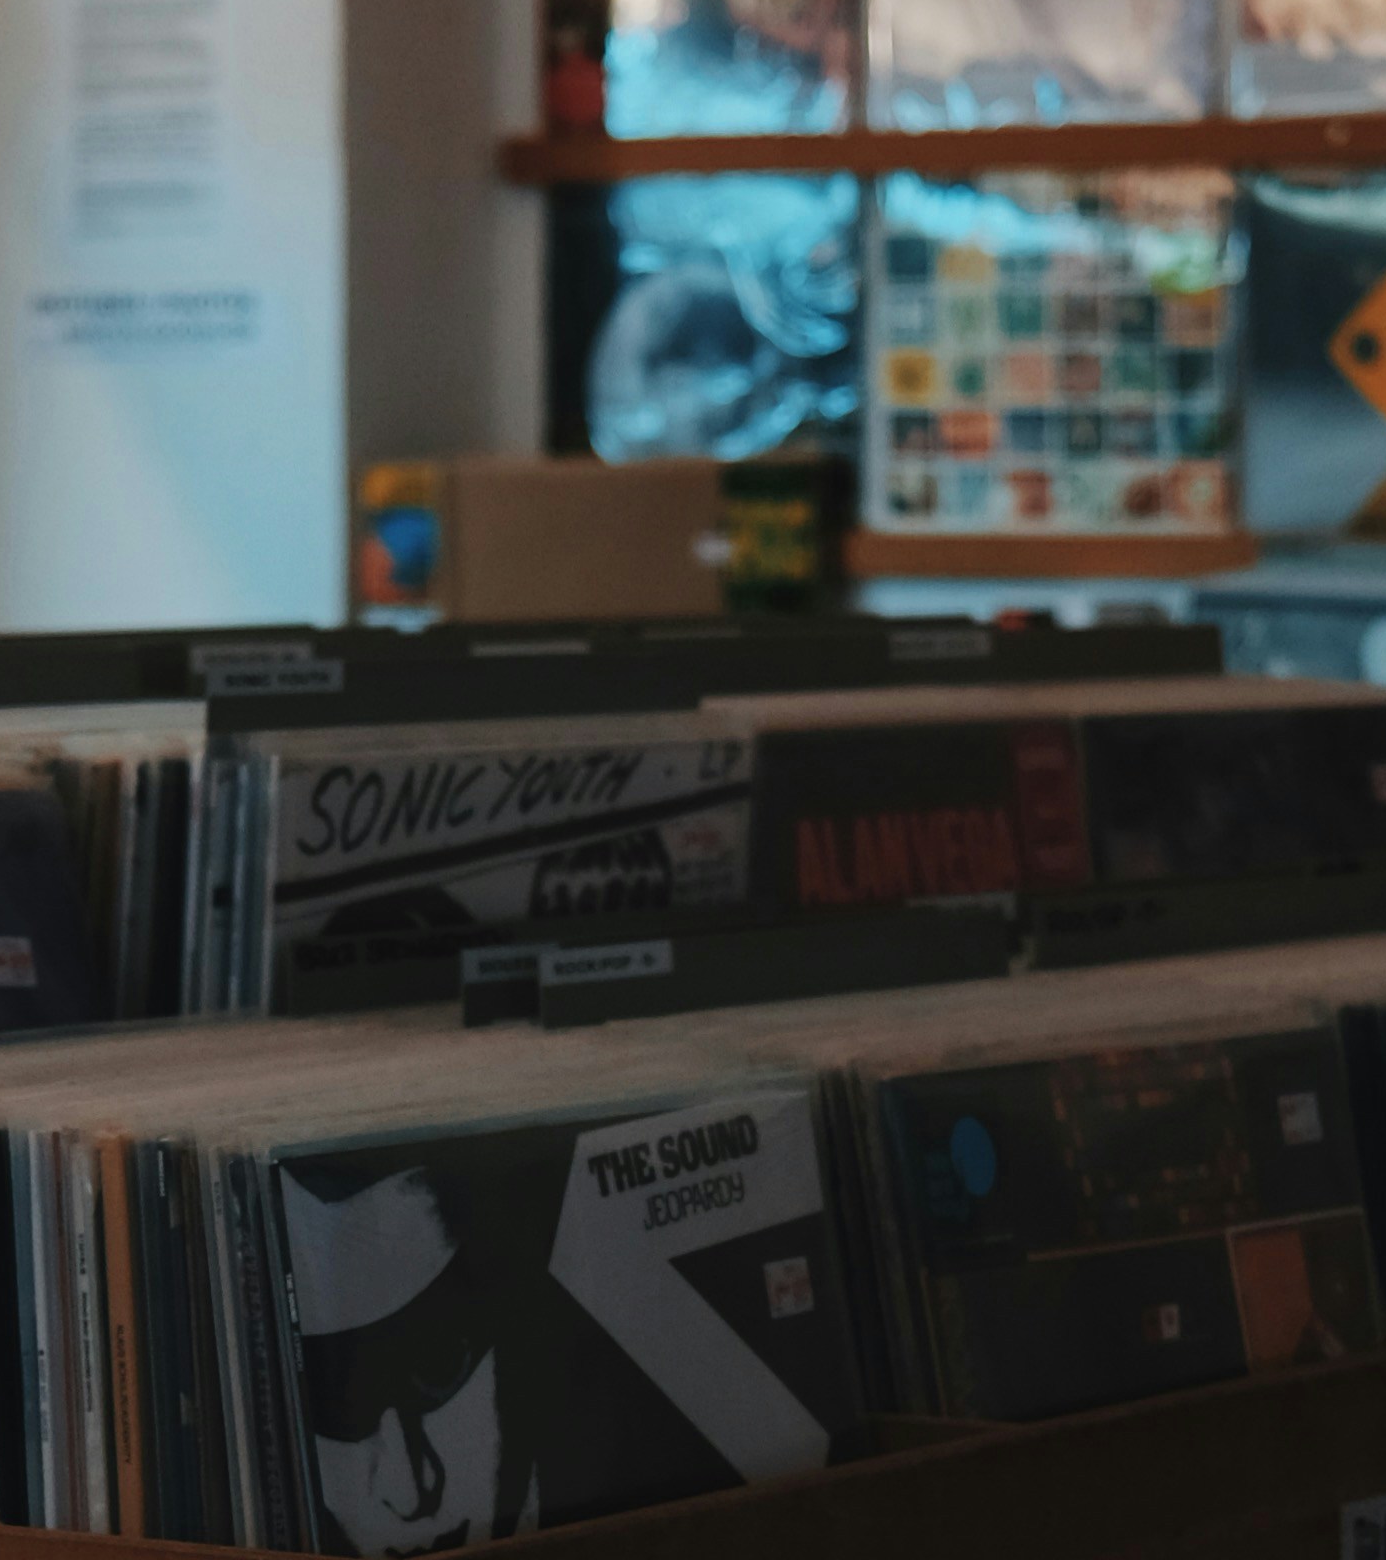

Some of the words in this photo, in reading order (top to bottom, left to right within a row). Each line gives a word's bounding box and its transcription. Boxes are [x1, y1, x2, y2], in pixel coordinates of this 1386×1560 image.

[297, 762, 483, 856] SONIC
[487, 751, 646, 822] YOUTH
[588, 1150, 656, 1198] THE
[655, 1113, 758, 1173] SOUND
[642, 1173, 747, 1232] JEOPARDY
